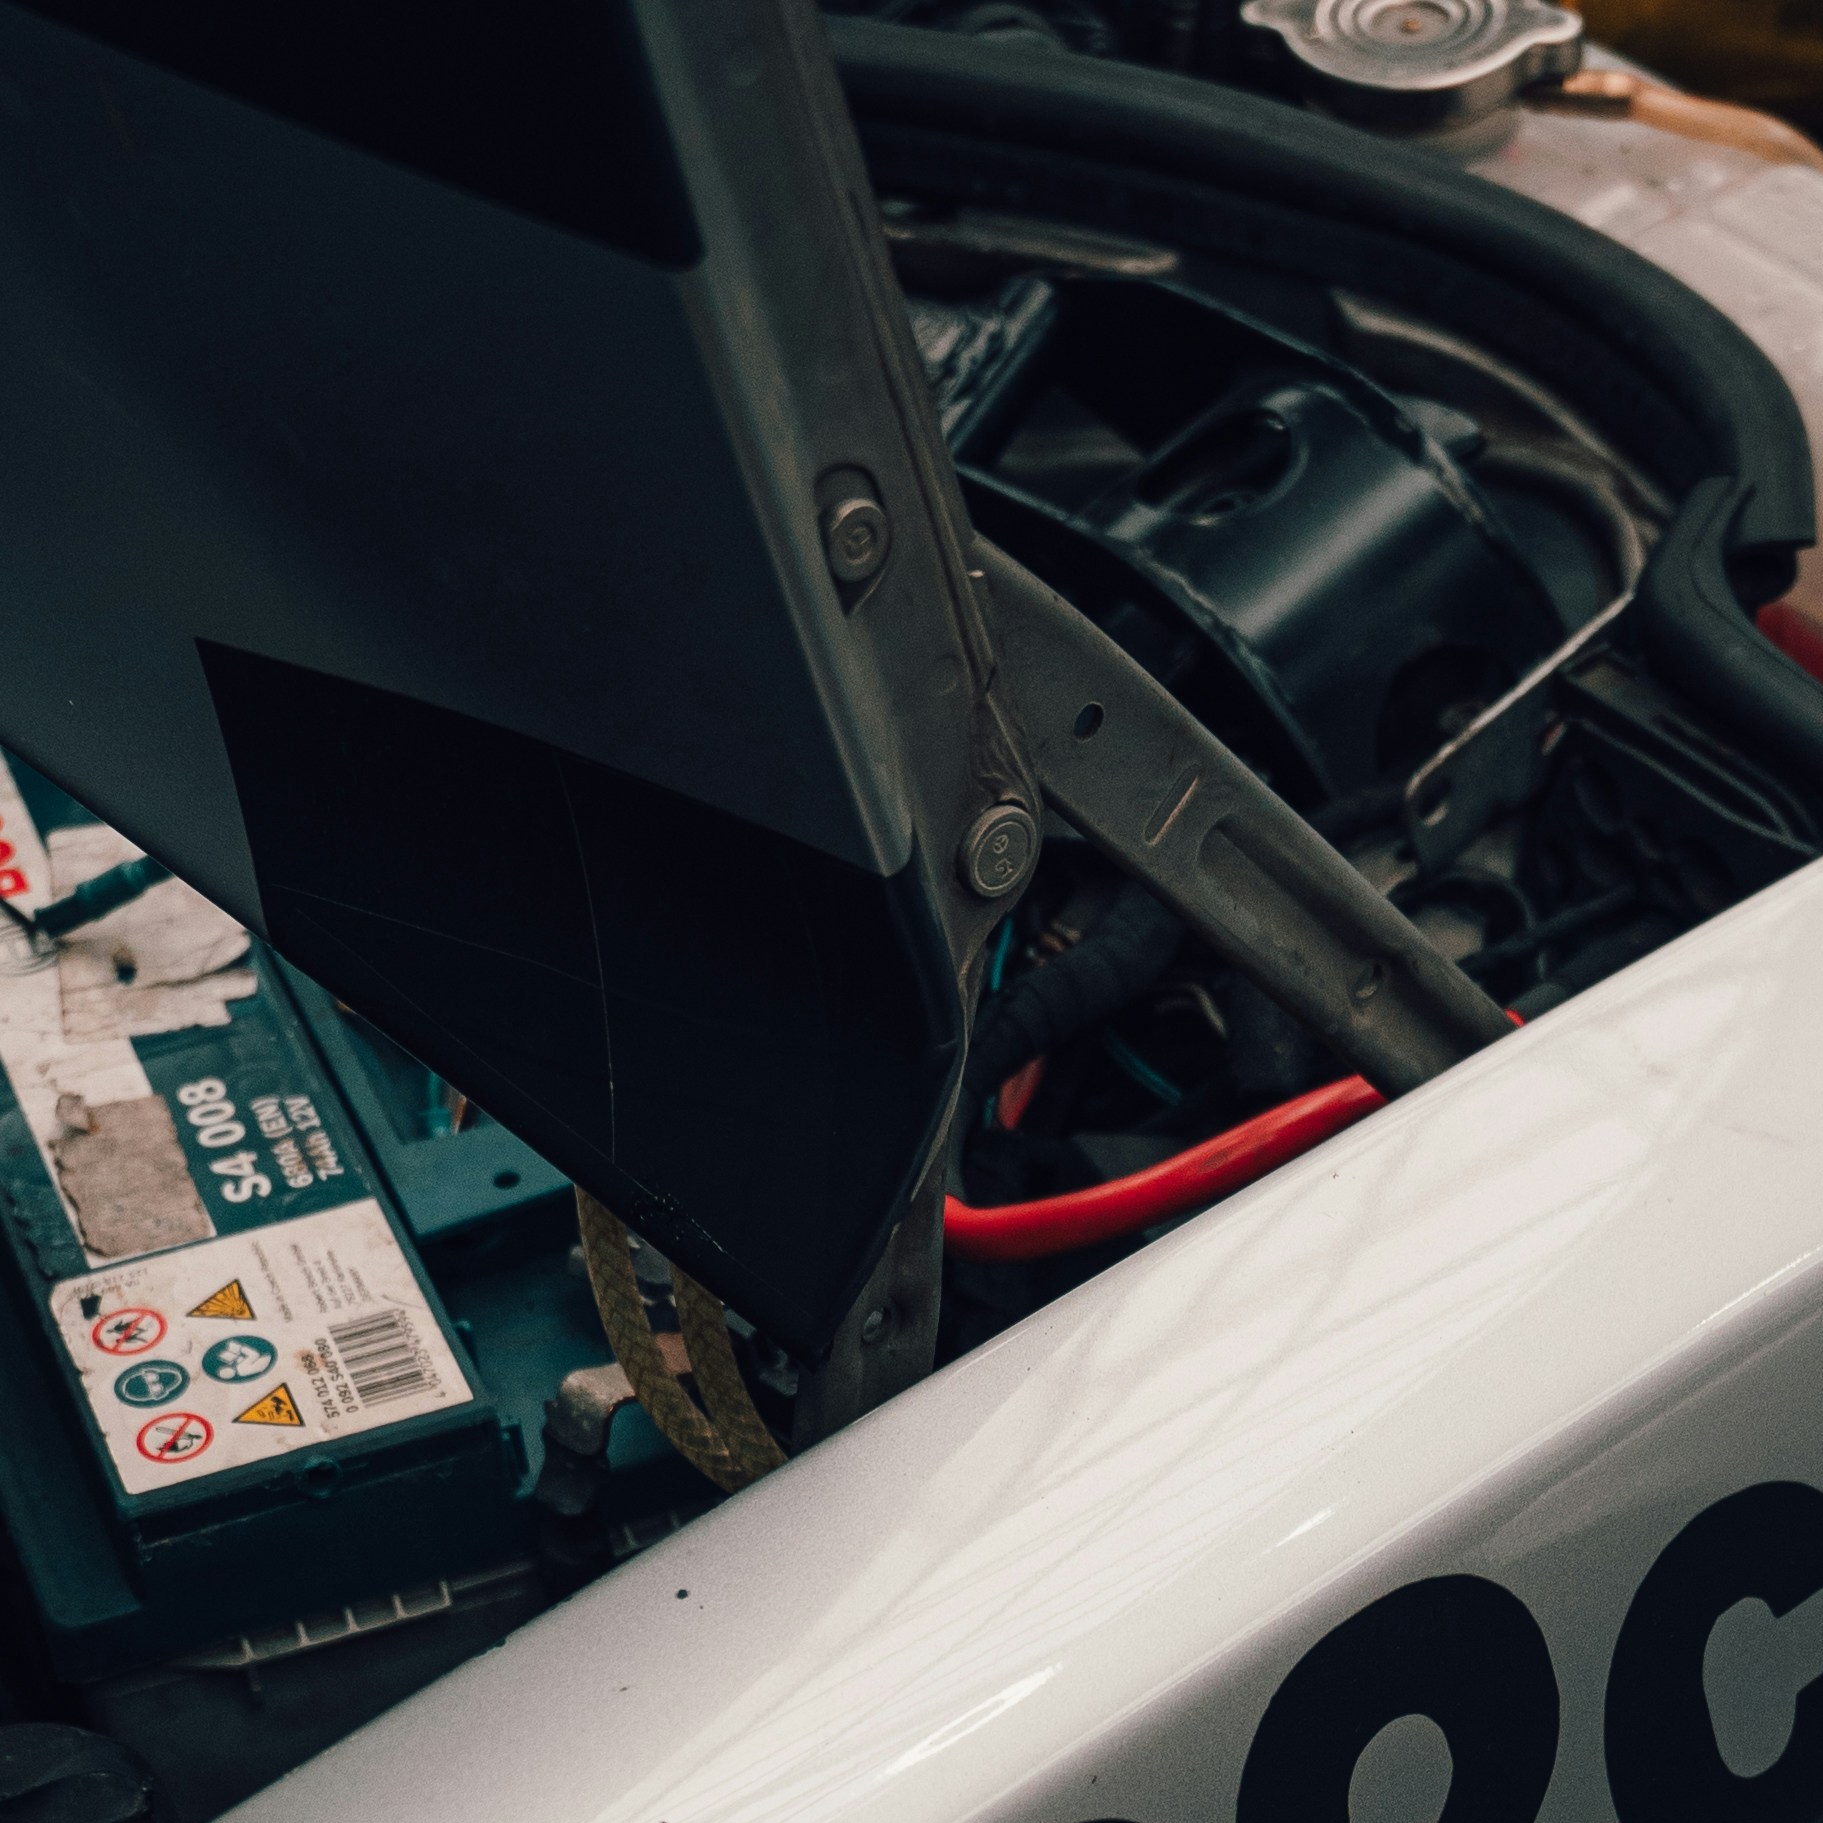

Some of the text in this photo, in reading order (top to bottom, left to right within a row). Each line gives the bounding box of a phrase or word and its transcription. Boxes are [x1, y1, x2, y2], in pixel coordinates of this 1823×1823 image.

[176, 1077, 247, 1148] 008
[250, 1094, 294, 1139] (EN)
[283, 1094, 322, 1131] 12V
[209, 1151, 272, 1203] S4
[311, 1376, 331, 1399] 012
[335, 1383, 355, 1405] 092
[323, 1398, 341, 1420] 574
